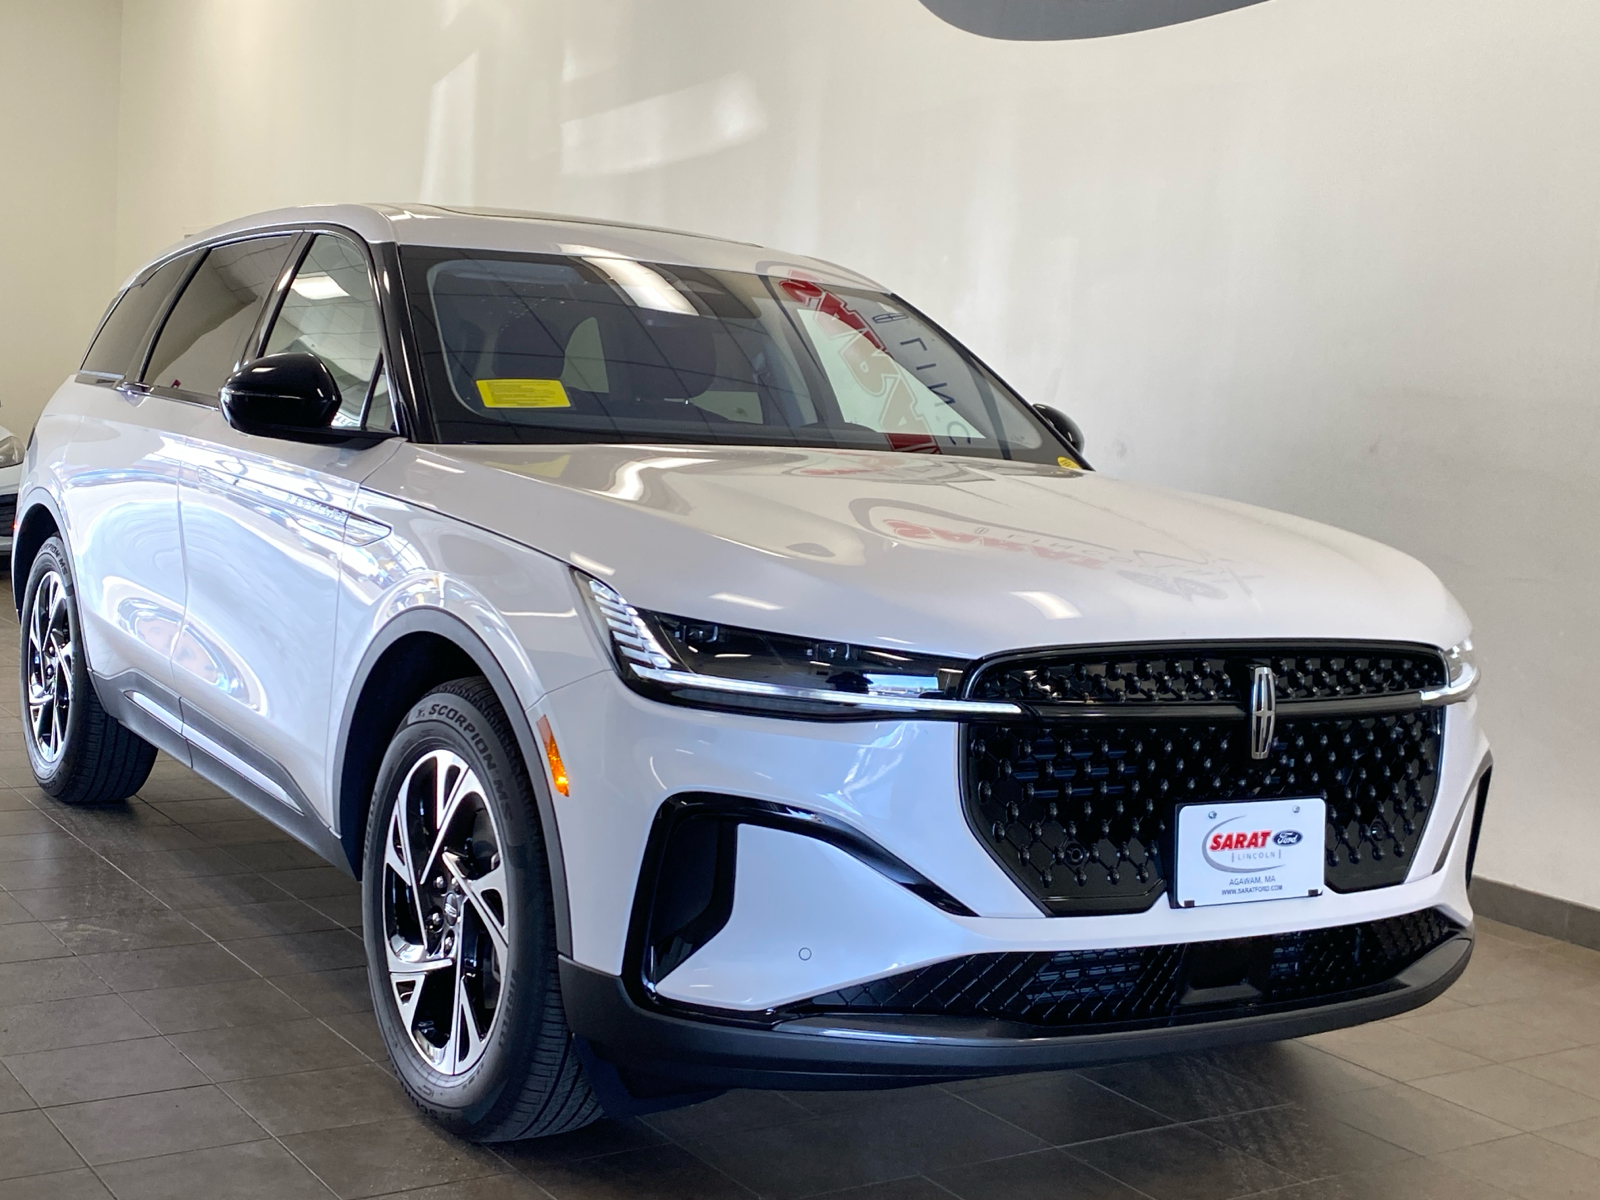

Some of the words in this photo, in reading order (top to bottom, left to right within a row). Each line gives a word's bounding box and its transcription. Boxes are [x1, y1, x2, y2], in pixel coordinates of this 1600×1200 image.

[428, 703, 497, 771] SCORPION
[1209, 830, 1273, 852] SARAT
[1275, 831, 1300, 846] Ford
[1237, 852, 1276, 861] LINCOLN
[1229, 876, 1263, 886] AGAWAM,
[1264, 875, 1276, 883] MA
